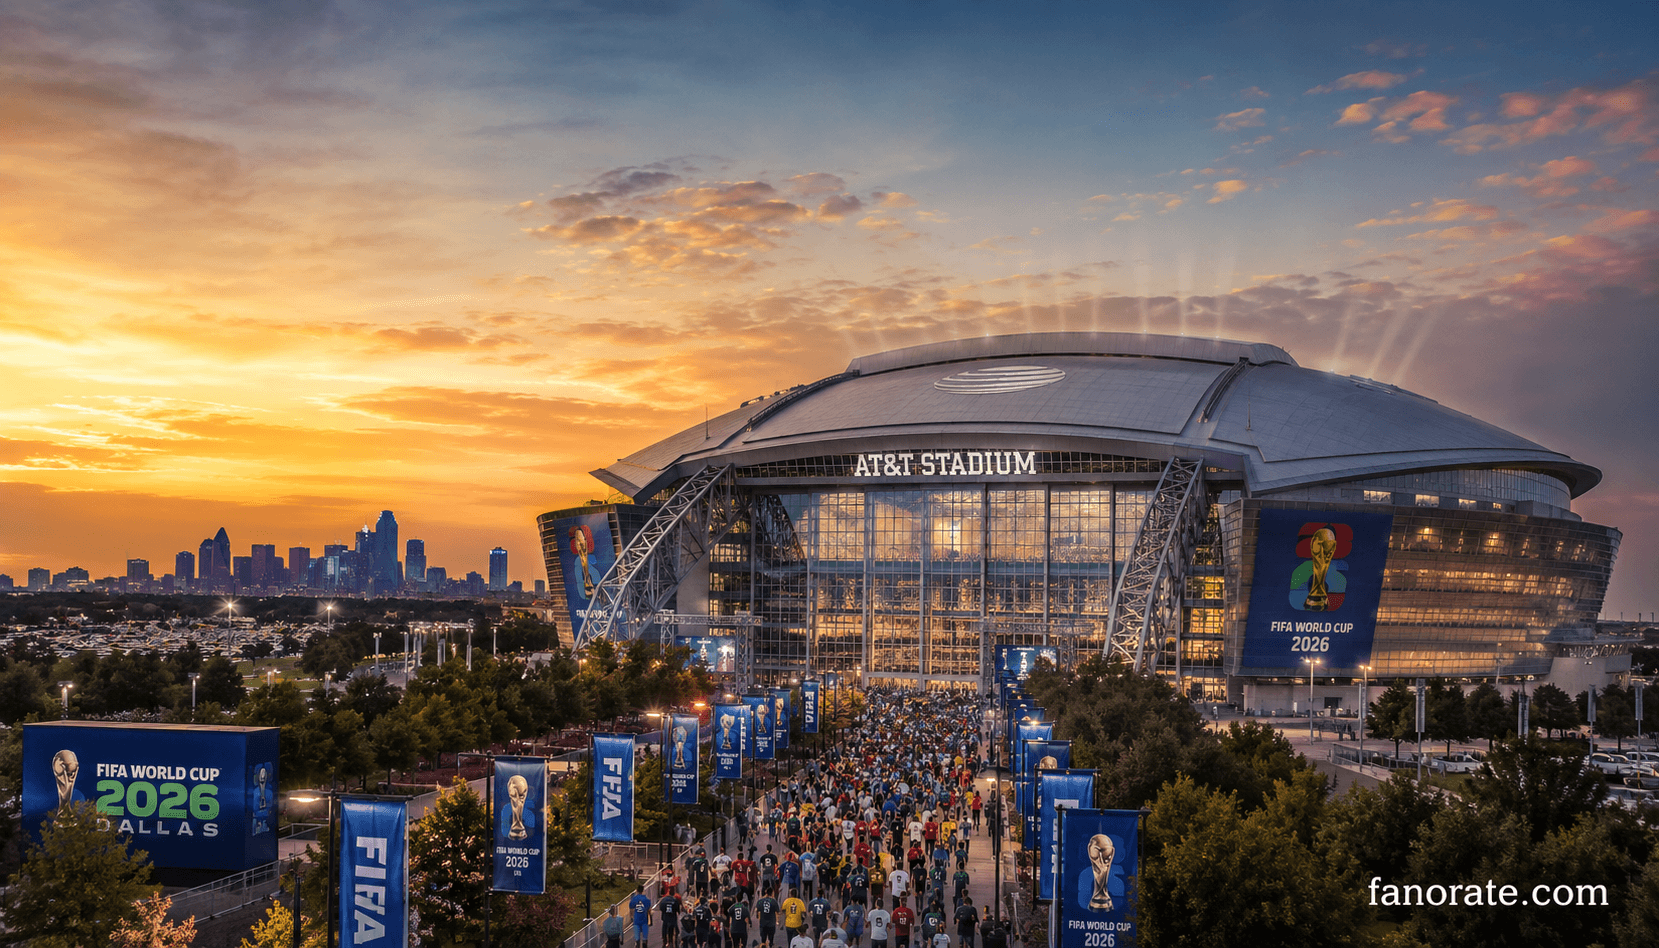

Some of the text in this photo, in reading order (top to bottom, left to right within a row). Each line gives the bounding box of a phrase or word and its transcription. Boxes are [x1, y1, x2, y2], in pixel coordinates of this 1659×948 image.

[854, 451, 1037, 477] AT&T STADIUM
[1271, 621, 1353, 633] FIFA WORLD CUP
[1291, 636, 1330, 652] 2026
[96, 763, 219, 781] FIFA WORLD CUP
[96, 779, 220, 820] 2026
[96, 818, 219, 836] DALLAS
[505, 855, 529, 868] 2026
[354, 836, 388, 945] FIFA
[1068, 920, 1131, 931] FIFA WORLD CUP
[1084, 932, 1115, 948] 2026
